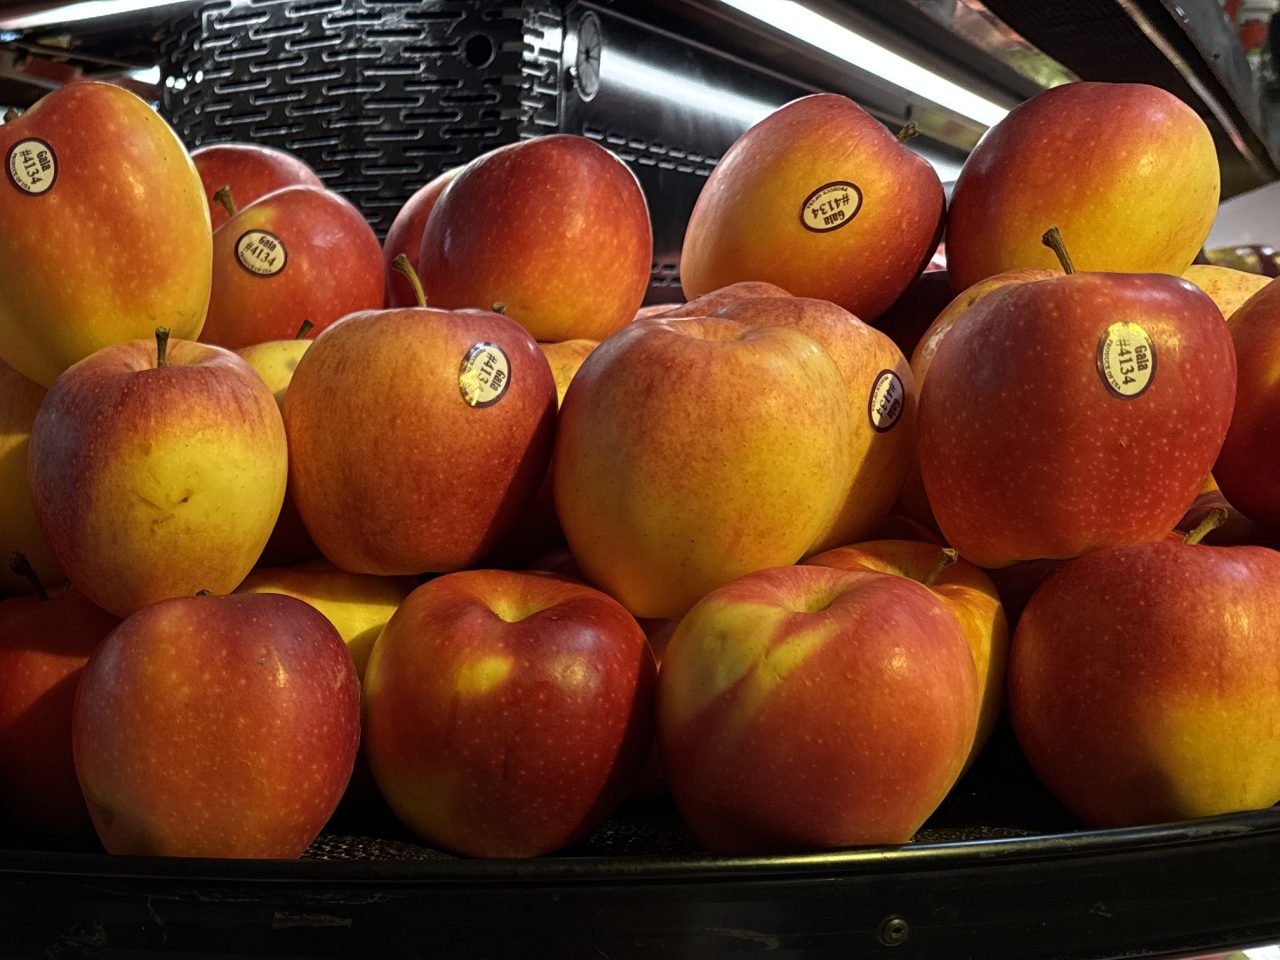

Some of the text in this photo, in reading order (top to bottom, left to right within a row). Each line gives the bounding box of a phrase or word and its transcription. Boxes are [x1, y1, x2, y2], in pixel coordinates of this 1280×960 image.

[19, 149, 43, 185] #4134
[36, 150, 51, 172] Gala
[811, 193, 850, 220] #4134
[823, 210, 846, 226] Gala
[243, 241, 276, 267] #4134
[258, 235, 277, 252] Gala
[1116, 338, 1137, 386] #4134
[1134, 345, 1150, 372] Gala
[489, 369, 506, 391] Gala
